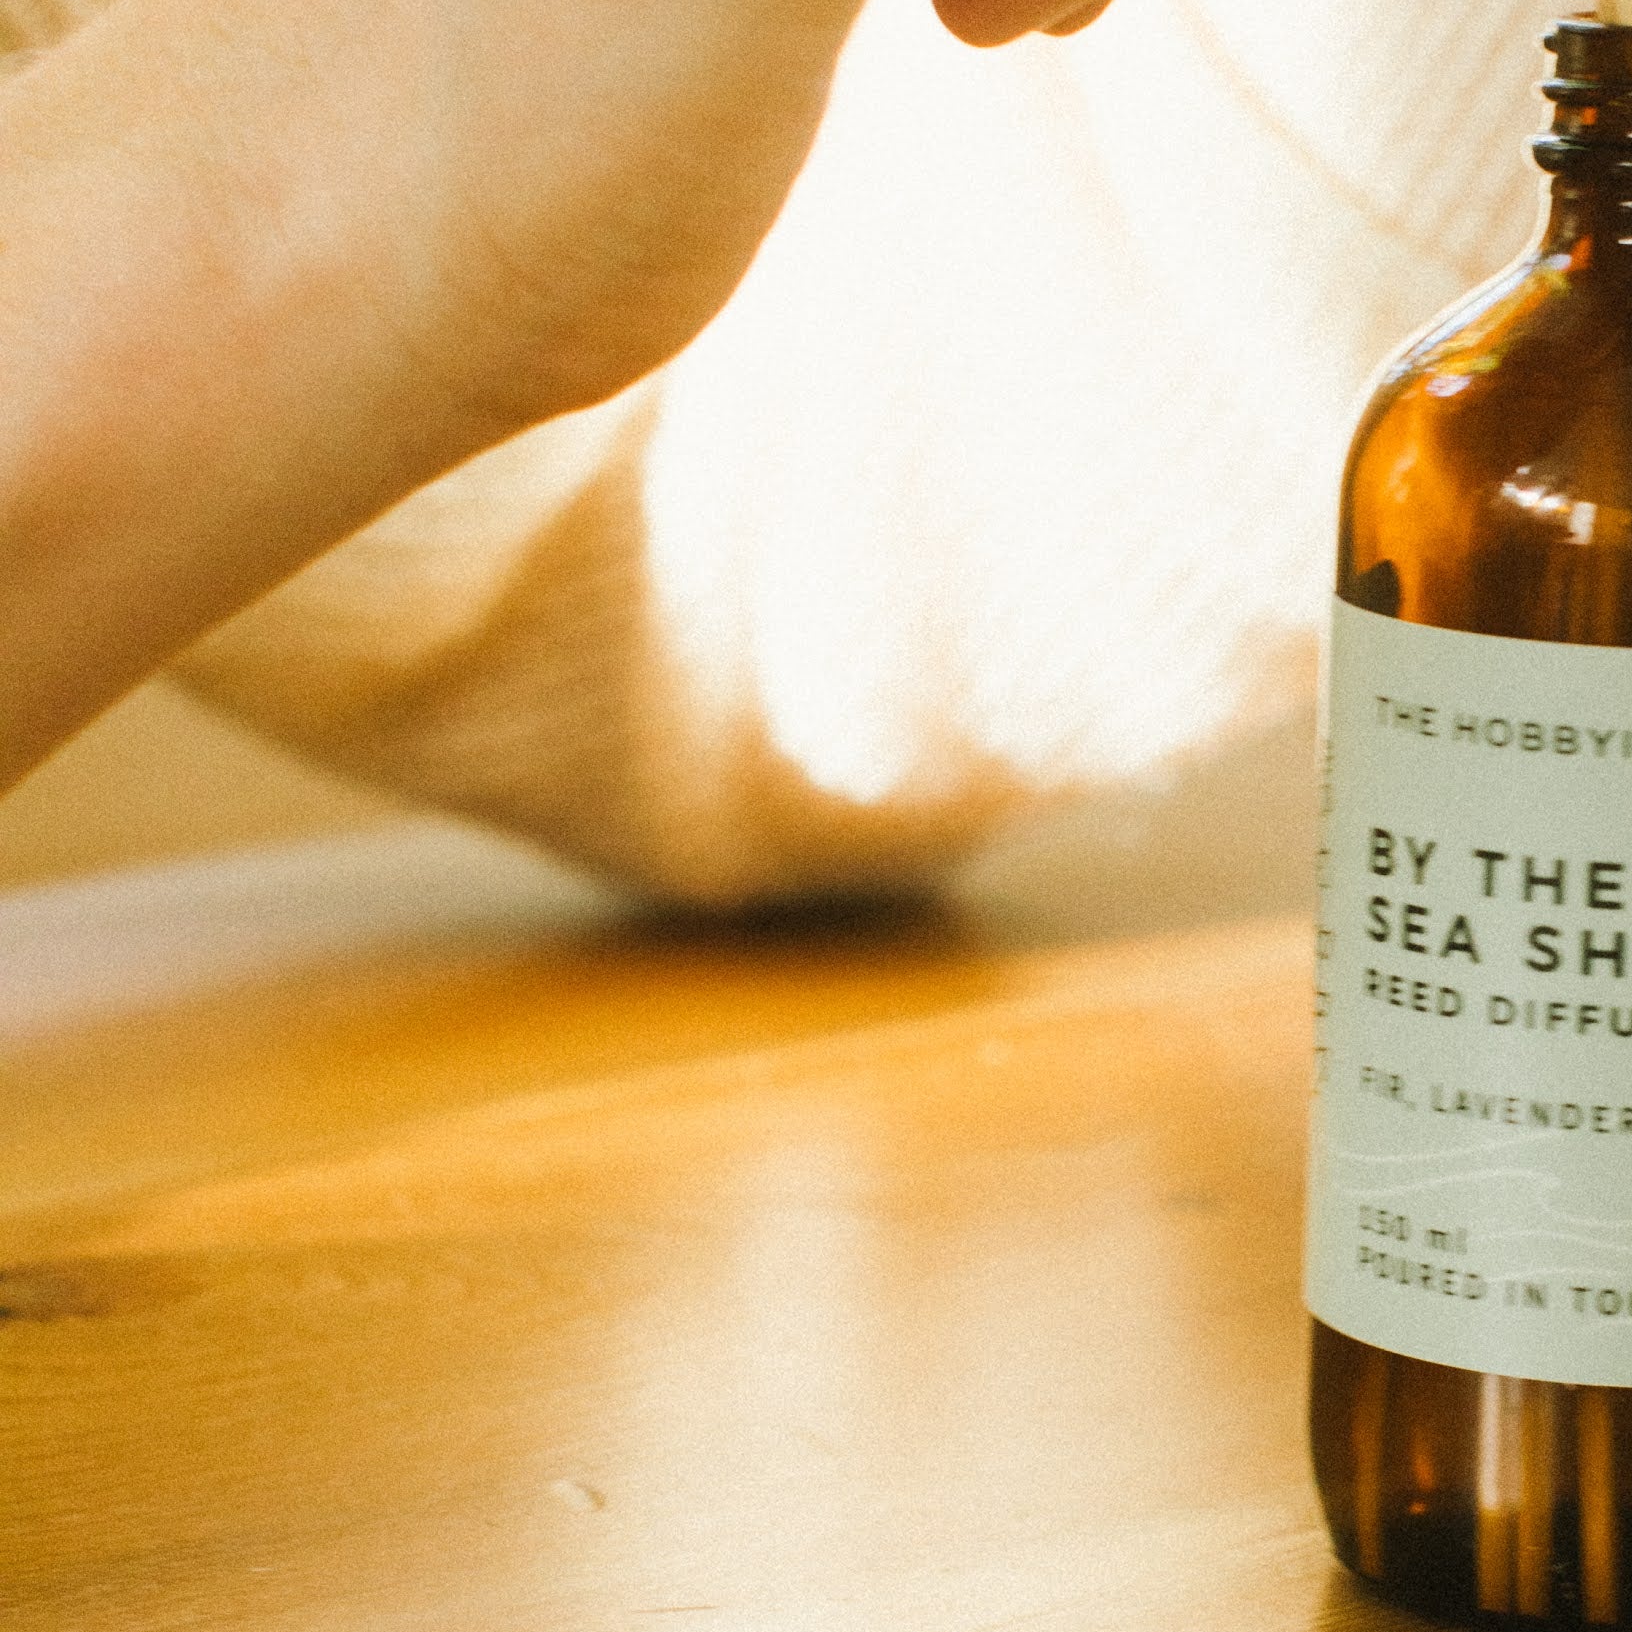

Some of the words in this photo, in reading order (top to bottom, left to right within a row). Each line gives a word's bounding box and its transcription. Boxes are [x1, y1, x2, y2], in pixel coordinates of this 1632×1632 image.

[1376, 695, 1438, 738] THE
[1368, 827, 1436, 885] BY
[1473, 848, 1627, 911] THE
[1366, 895, 1481, 964] SEA
[1365, 967, 1464, 1018] REED
[1424, 1226, 1469, 1256] ml
[1357, 1244, 1488, 1301] POURED
[1504, 1281, 1549, 1311] IN
